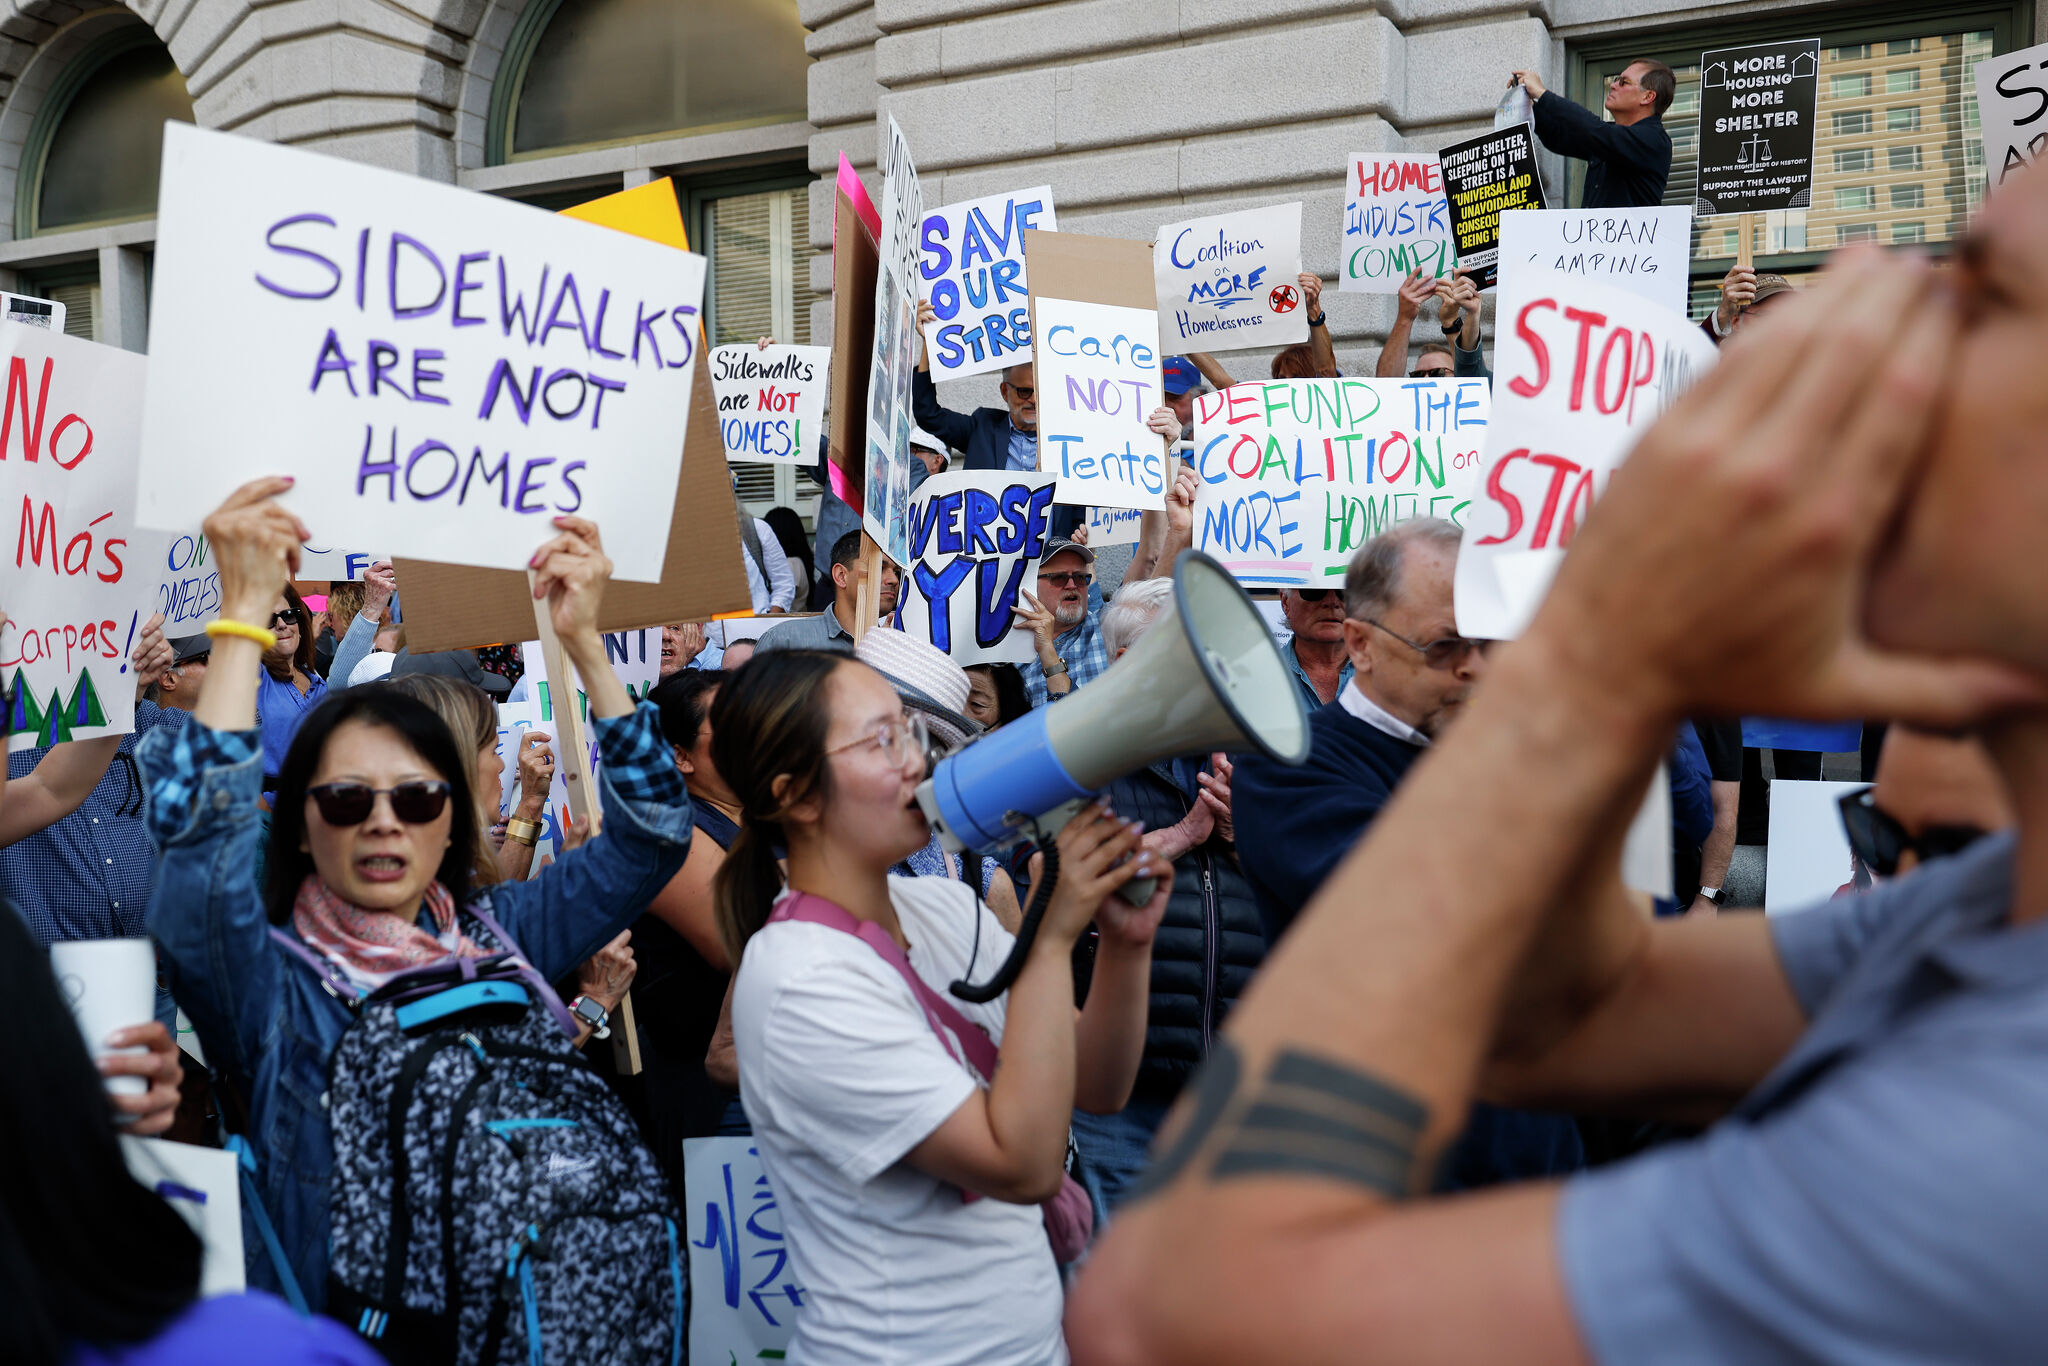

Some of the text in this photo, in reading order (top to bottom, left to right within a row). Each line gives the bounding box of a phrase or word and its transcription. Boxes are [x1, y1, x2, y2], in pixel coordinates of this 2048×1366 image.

[1725, 73, 1793, 91] HOUSING
[1733, 54, 1786, 74] MORE
[1732, 90, 1784, 109] MORE
[1996, 59, 2048, 126] S
[1715, 110, 1798, 133] SHELTER
[1442, 133, 1527, 170] WITHOUT SHELTER,
[1448, 147, 1527, 181] SLEEPING ON THE
[1734, 163, 1753, 171] RIGHT
[1357, 160, 1446, 197] HOME
[1462, 164, 1516, 191] STREET IS A
[1510, 173, 1532, 192] AND
[1703, 174, 1808, 191] SUPPORT THE LAWSUIT
[1717, 187, 1791, 200] STOP THE SWEEPS
[1346, 198, 1451, 239] INDUSTR
[1461, 190, 1527, 220] UNAVOIDABLE
[920, 198, 1043, 280] SAVE
[1171, 228, 1264, 269] Coalition
[1461, 230, 1490, 249] BEING
[1563, 217, 1659, 246] URBAN
[1214, 266, 1230, 277] on
[1528, 253, 1660, 275] AMPING
[255, 213, 697, 370] SIDEWALKS
[931, 258, 1028, 321] OUR
[1188, 265, 1267, 303] MORE
[936, 308, 1032, 368] STRE
[1176, 309, 1263, 339] Homelessness
[714, 350, 814, 382] Sidewalks
[1048, 325, 1155, 369] Care
[1507, 297, 1656, 427] STOP
[310, 328, 451, 405] ARE
[478, 358, 627, 429] NOT
[719, 385, 801, 413] are NOT
[1066, 375, 1152, 423] NOT
[1199, 381, 1487, 434] DEFUND THE
[0, 356, 93, 470] No
[357, 425, 587, 514] HOMES
[1048, 435, 1163, 494] Tents
[1200, 431, 1482, 489] COALITION on
[16, 494, 126, 584] Más
[909, 482, 1056, 562] VERSE
[1201, 490, 1303, 559] MORE
[168, 534, 210, 571] ON
[894, 554, 1029, 655] YU
